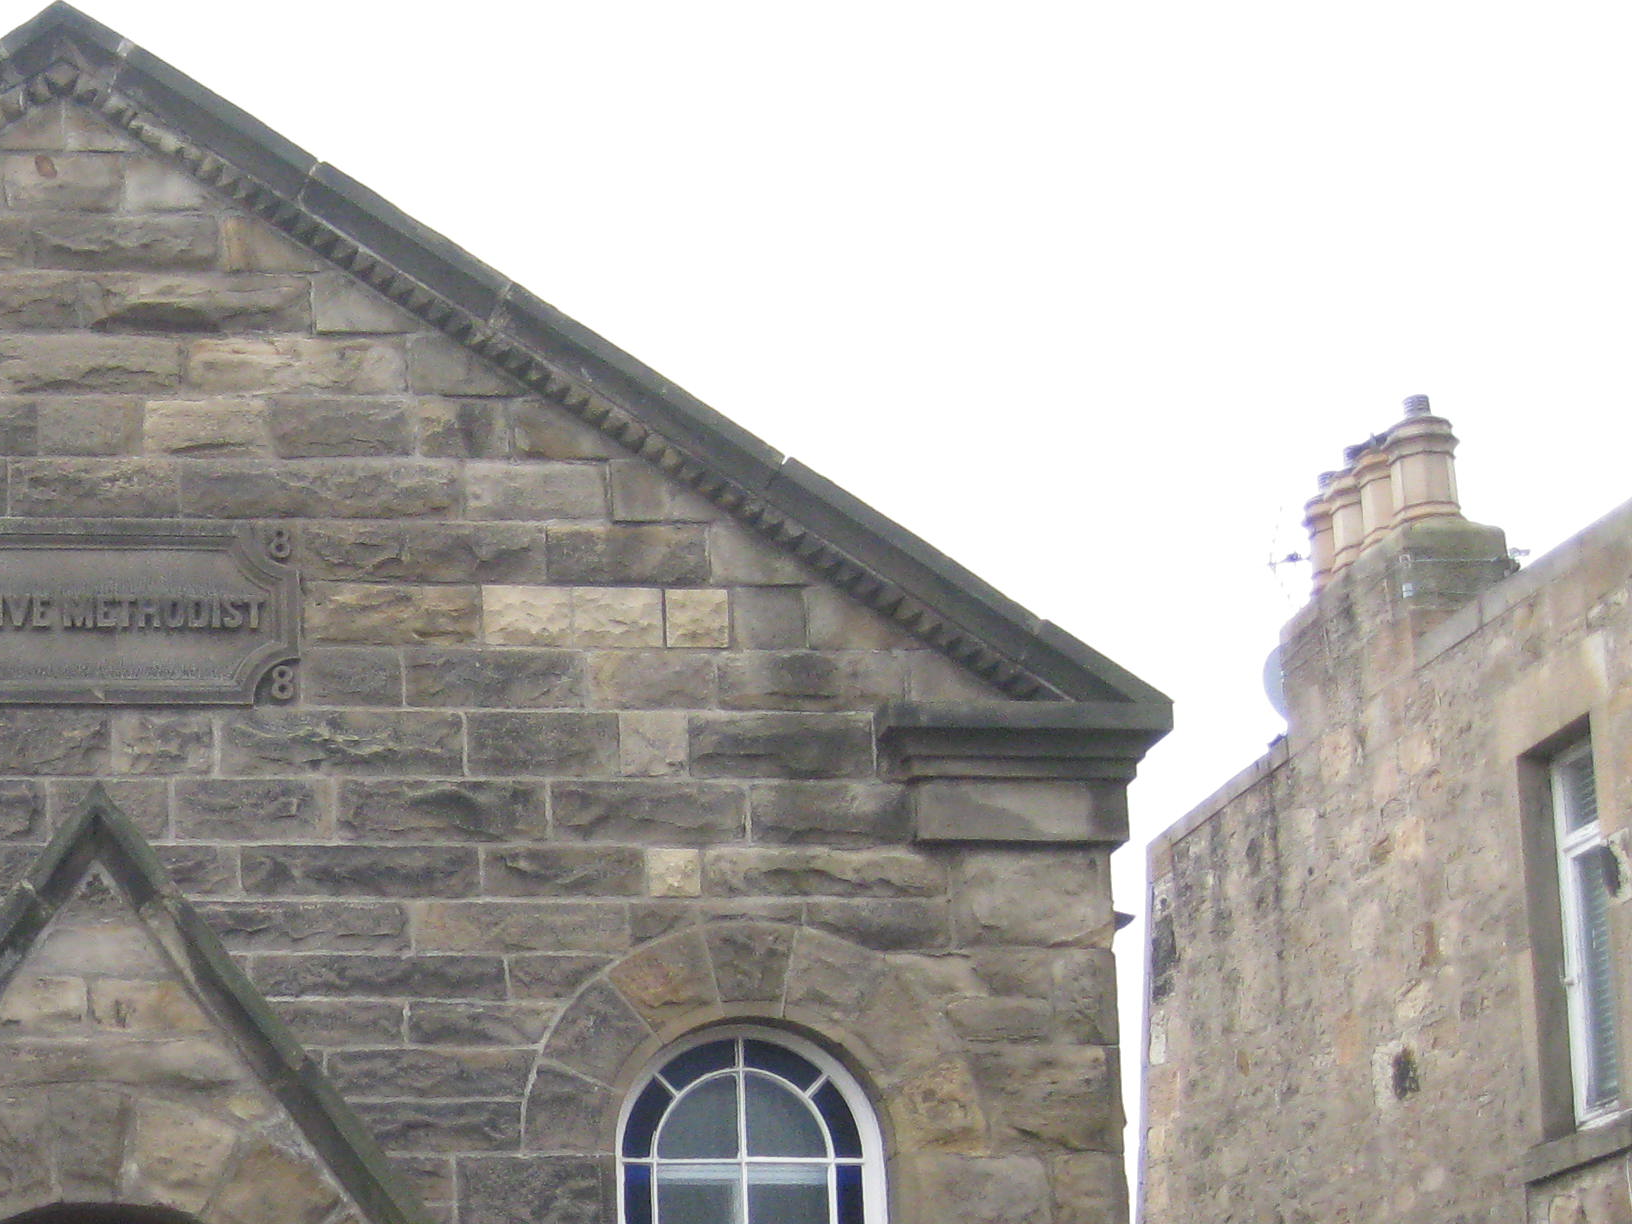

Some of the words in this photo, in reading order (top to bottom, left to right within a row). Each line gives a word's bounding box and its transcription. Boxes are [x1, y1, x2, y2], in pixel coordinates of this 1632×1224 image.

[269, 529, 291, 558] 8
[65, 599, 264, 629] METHODIST
[271, 665, 294, 699] 8
